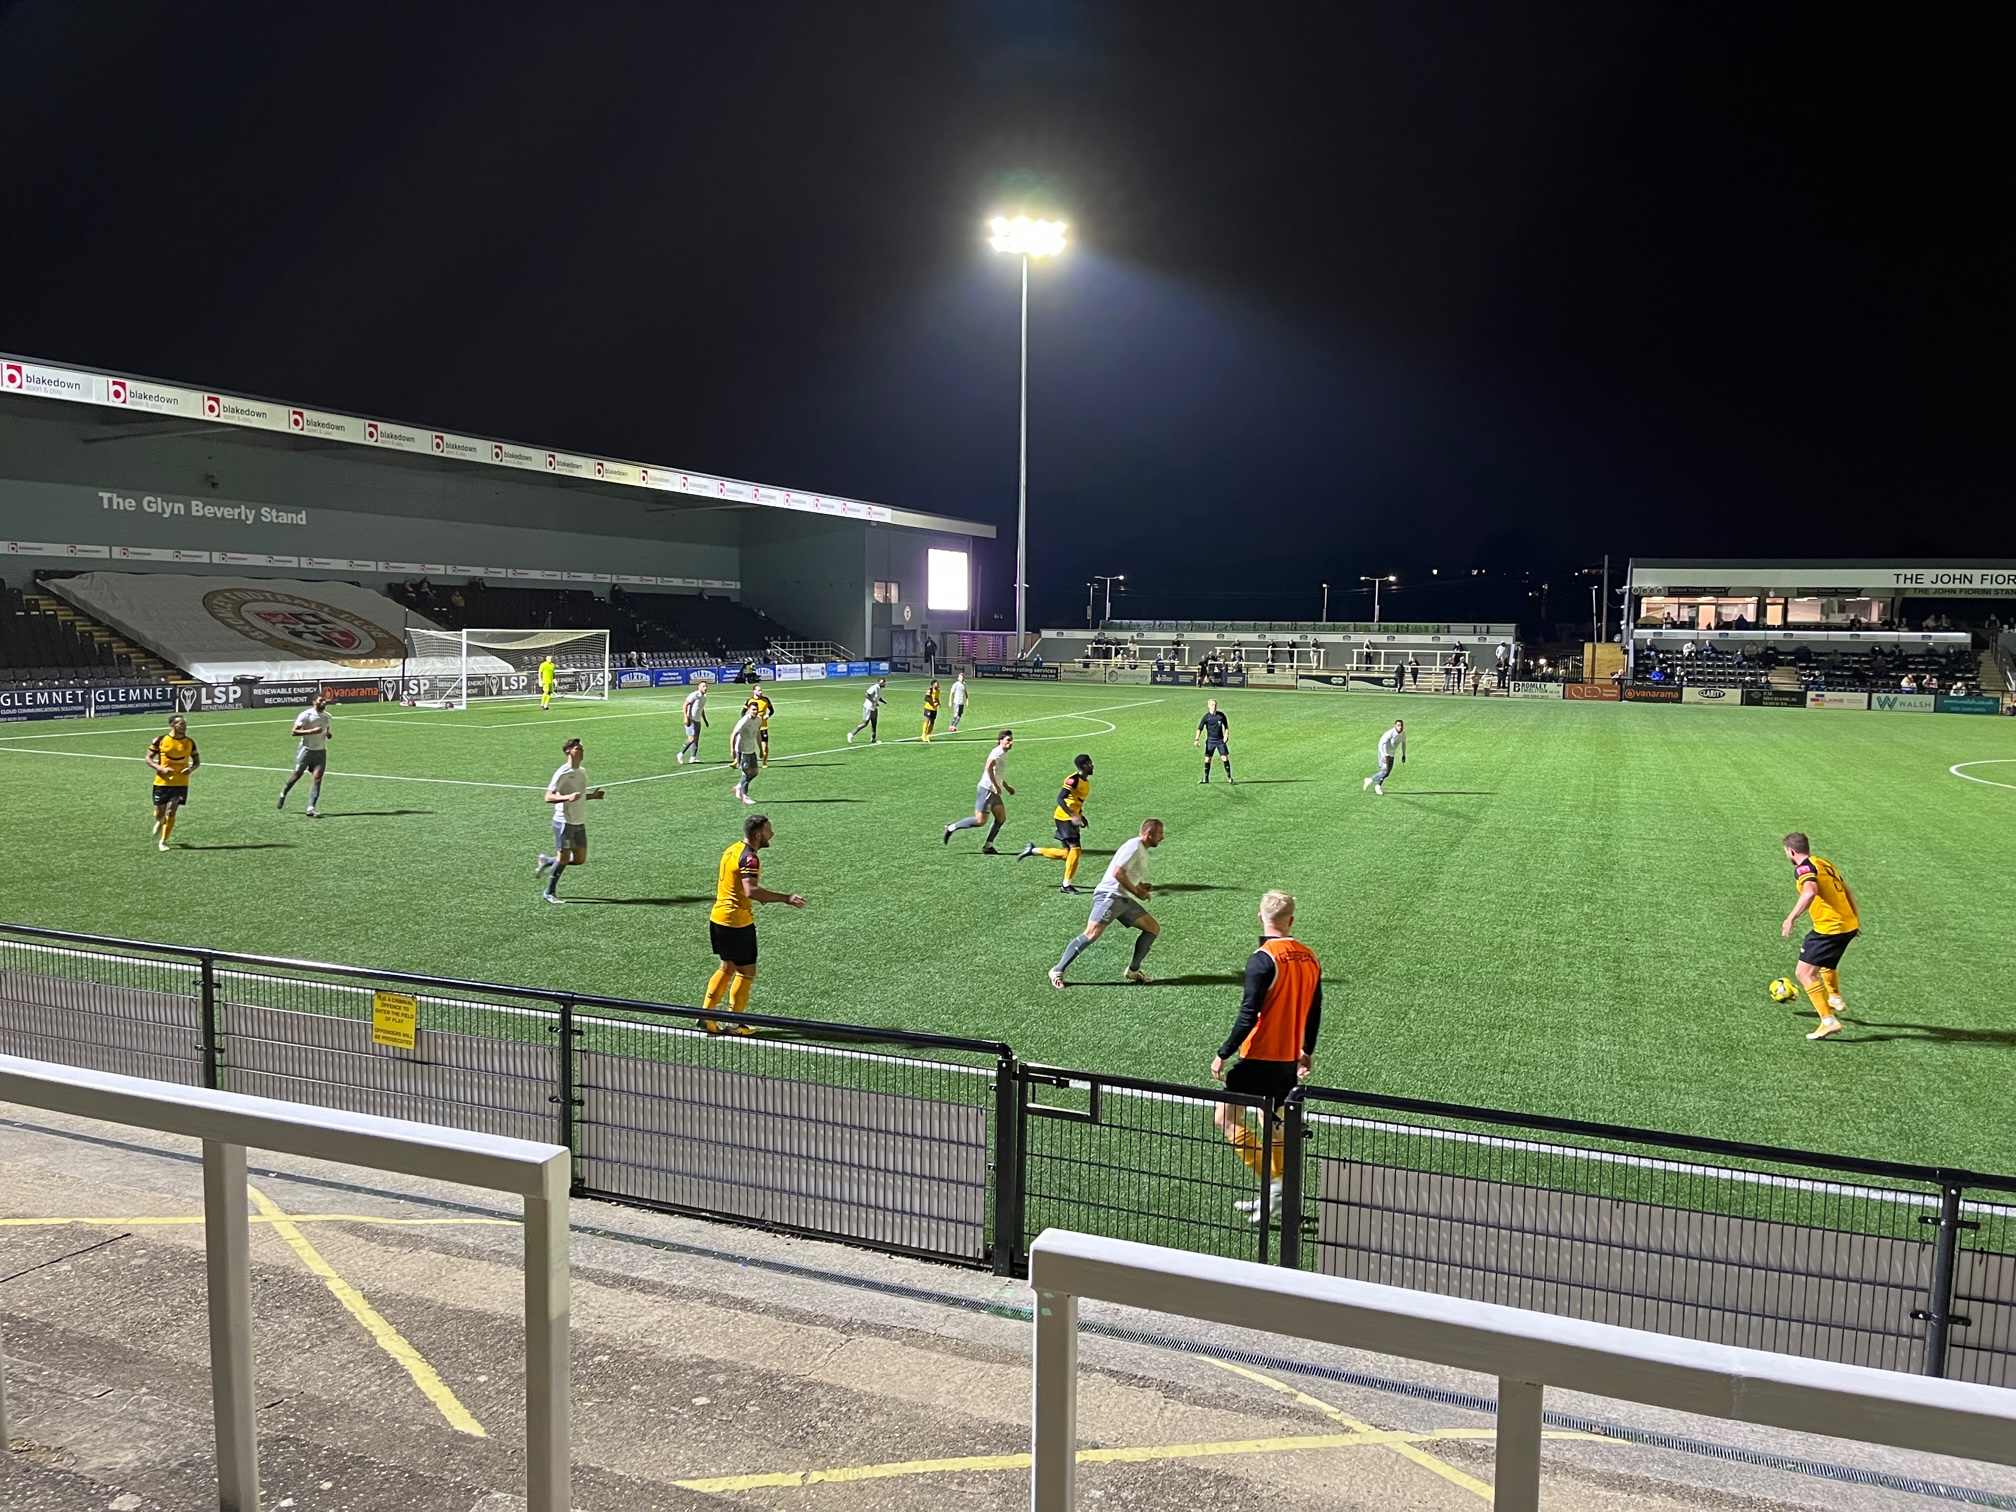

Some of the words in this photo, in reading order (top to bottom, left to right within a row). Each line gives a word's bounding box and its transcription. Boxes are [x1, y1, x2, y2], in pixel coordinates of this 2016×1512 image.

[26, 374, 81, 390] blakedown
[129, 389, 179, 405] blakedown
[223, 404, 267, 419] blakedown
[306, 418, 346, 432] blakedown
[380, 430, 415, 443] blakedown
[445, 441, 477, 453] blakedown
[504, 452, 533, 462] blakedown
[98, 492, 137, 511] The
[142, 496, 185, 518] Glyn
[191, 500, 255, 524] Beverly
[260, 507, 307, 525] Stand
[1893, 573, 1924, 585] THE
[1930, 573, 1973, 585] JOHN
[1980, 574, 2016, 585] FIOR
[620, 671, 650, 683] WALKERS
[689, 669, 716, 680] WALKERS
[502, 676, 528, 690] LSP
[95, 687, 173, 702] GLEMNET
[201, 685, 242, 704] LSP
[253, 687, 292, 695] RENEWABLE
[293, 686, 317, 694] ENERGY
[333, 687, 379, 697] vanarama
[1571, 686, 1601, 699] QED
[1635, 690, 1679, 699] vanarama
[1699, 688, 1724, 697] CLARITY
[0, 690, 84, 706] GLEMNET
[264, 696, 308, 704] RECRUITMENT
[201, 703, 243, 711] RENEWABLES
[380, 1002, 402, 1010] OFFENCE
[375, 1028, 401, 1037] OFFENDERS
[382, 1036, 412, 1046] PROSECUTED
